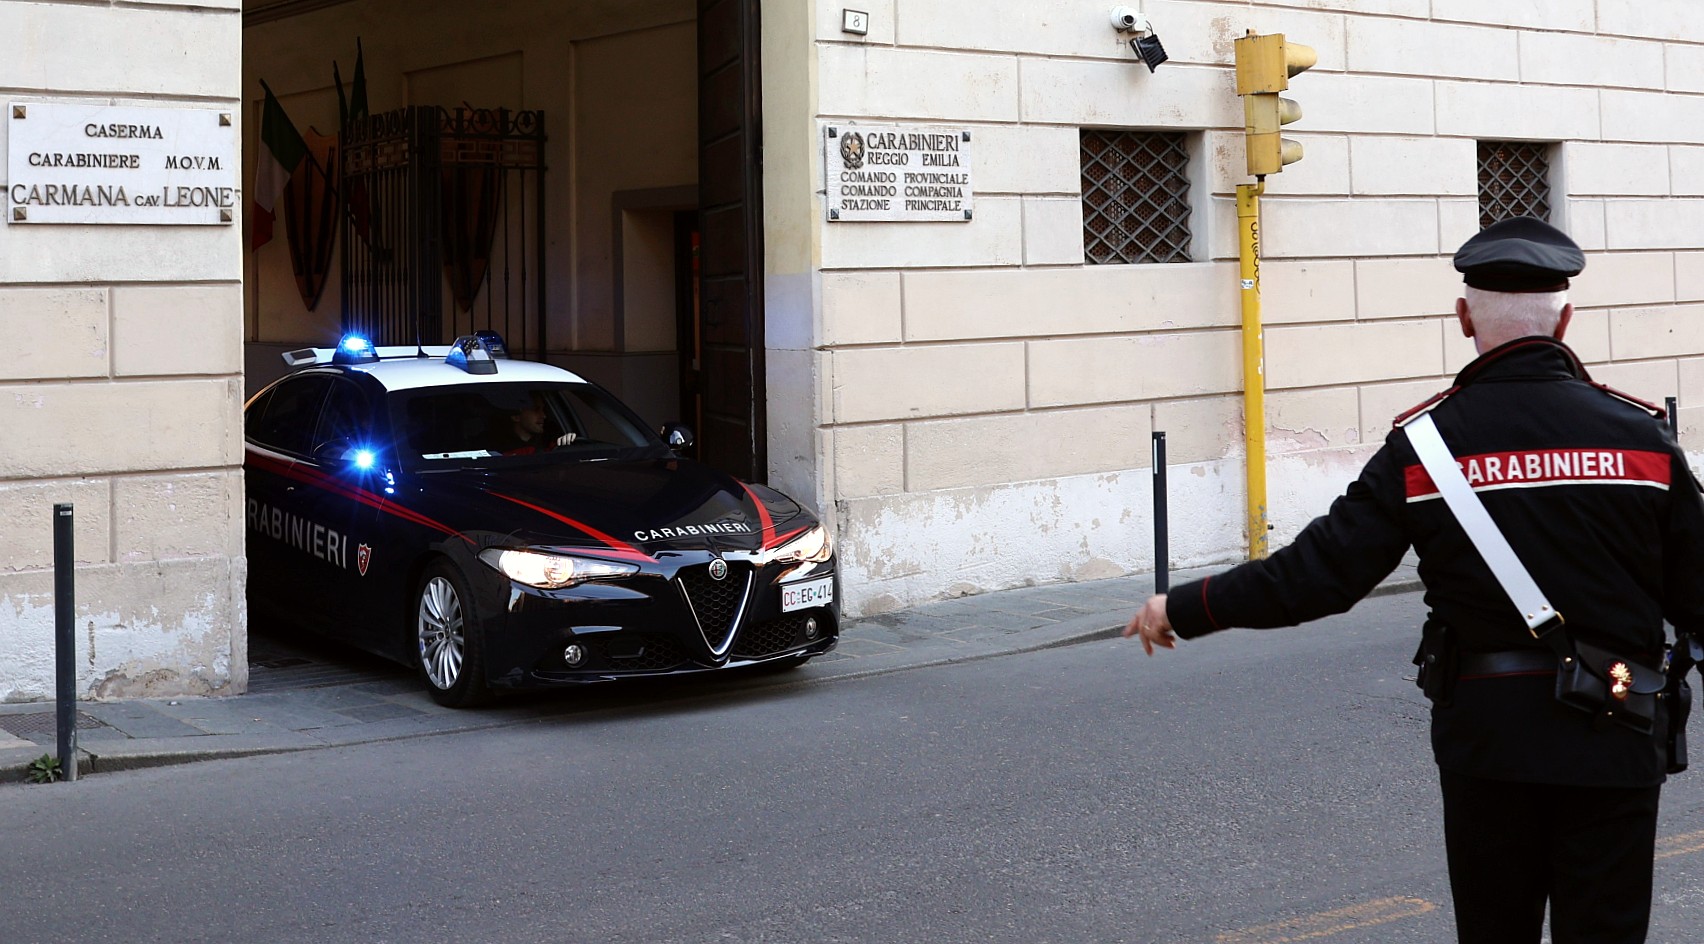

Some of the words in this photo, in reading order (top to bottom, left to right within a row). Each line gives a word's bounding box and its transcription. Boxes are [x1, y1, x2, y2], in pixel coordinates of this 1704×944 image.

[853, 14, 860, 28] 8
[85, 123, 164, 140] CASERMA
[866, 132, 959, 152] CARABINIERI
[28, 152, 140, 169] CARABINIERE
[867, 151, 909, 166] REGGIO
[922, 153, 960, 167] EMILIA
[840, 171, 897, 183] COMANDO
[904, 172, 969, 185] PROVINCIALE
[11, 184, 131, 206] CARMANA
[163, 186, 235, 208] LEONE
[841, 185, 897, 197] COMANDO
[904, 186, 964, 198] COMPAGNIA
[841, 199, 890, 211] STAZIONE
[905, 200, 962, 212] PRINCIPALE
[1456, 451, 1625, 484] ARABINIERI
[247, 497, 348, 570] RABINIERI
[634, 522, 751, 542] CARABINIERI
